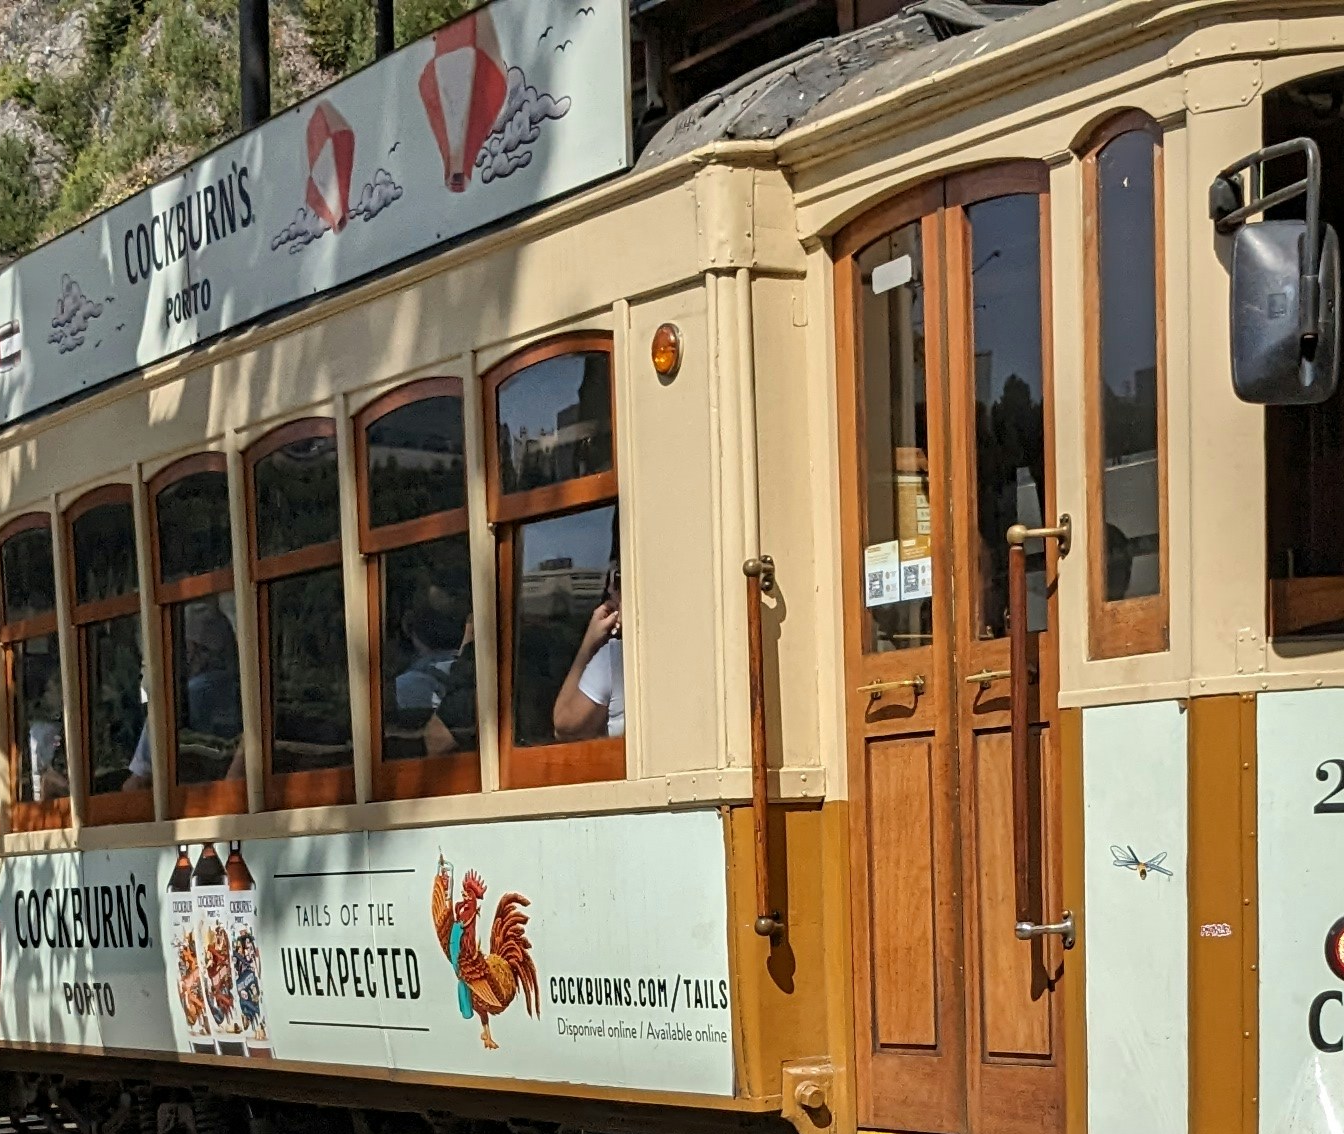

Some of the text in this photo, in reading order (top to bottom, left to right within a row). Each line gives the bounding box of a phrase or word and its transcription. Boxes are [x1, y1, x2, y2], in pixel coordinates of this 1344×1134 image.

[165, 278, 212, 329] PORTO
[295, 903, 395, 927] TAILS OF THE
[280, 947, 421, 1000] UNEXPECTED
[63, 982, 116, 1017] PORTO
[557, 1016, 606, 1042] Disponível
[607, 1020, 638, 1040] online
[646, 1021, 693, 1042] Available
[695, 1023, 728, 1043] online
